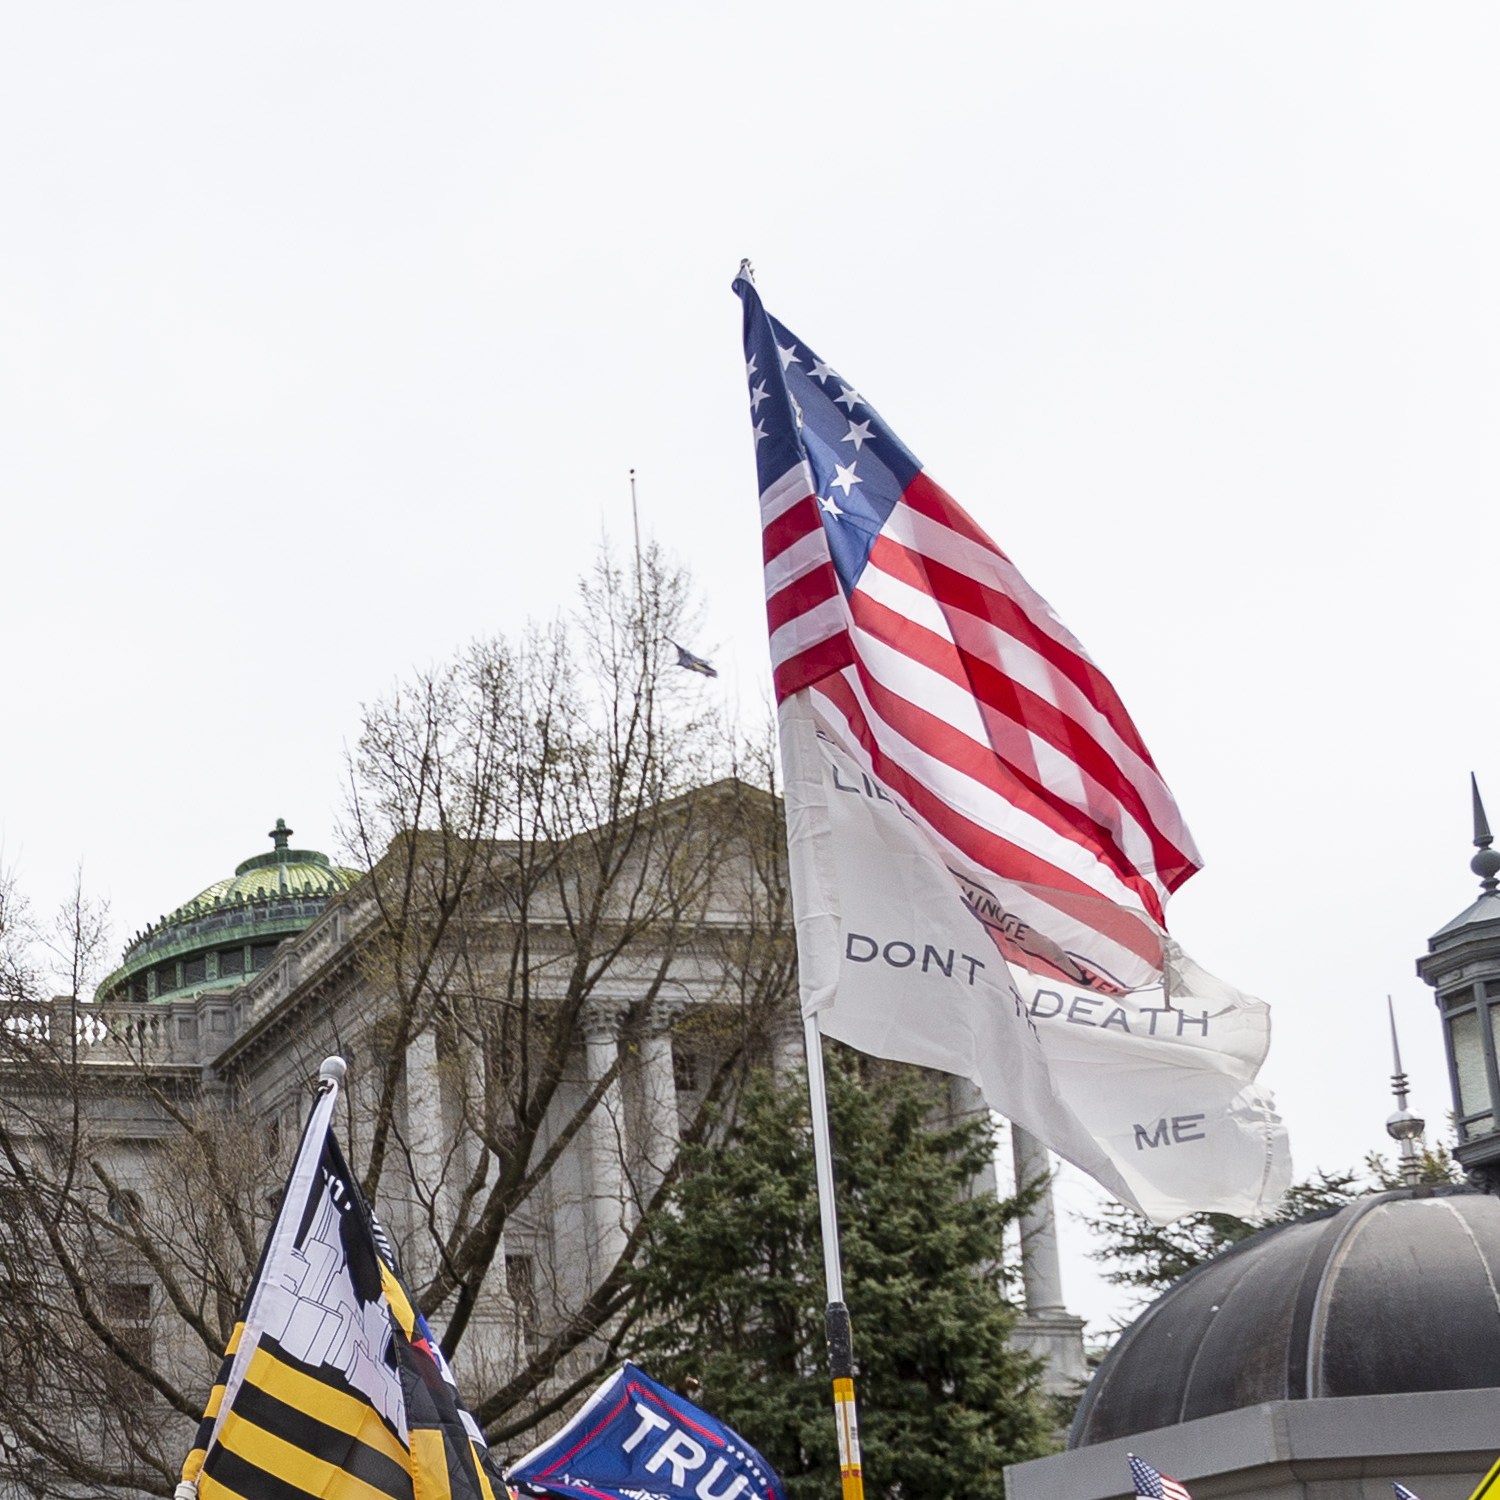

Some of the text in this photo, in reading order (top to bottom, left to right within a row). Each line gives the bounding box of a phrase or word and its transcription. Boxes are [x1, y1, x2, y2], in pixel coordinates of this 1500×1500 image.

[845, 931, 986, 986] DONT
[1029, 987, 1211, 1039] DEATH
[1132, 1113, 1206, 1152] ME
